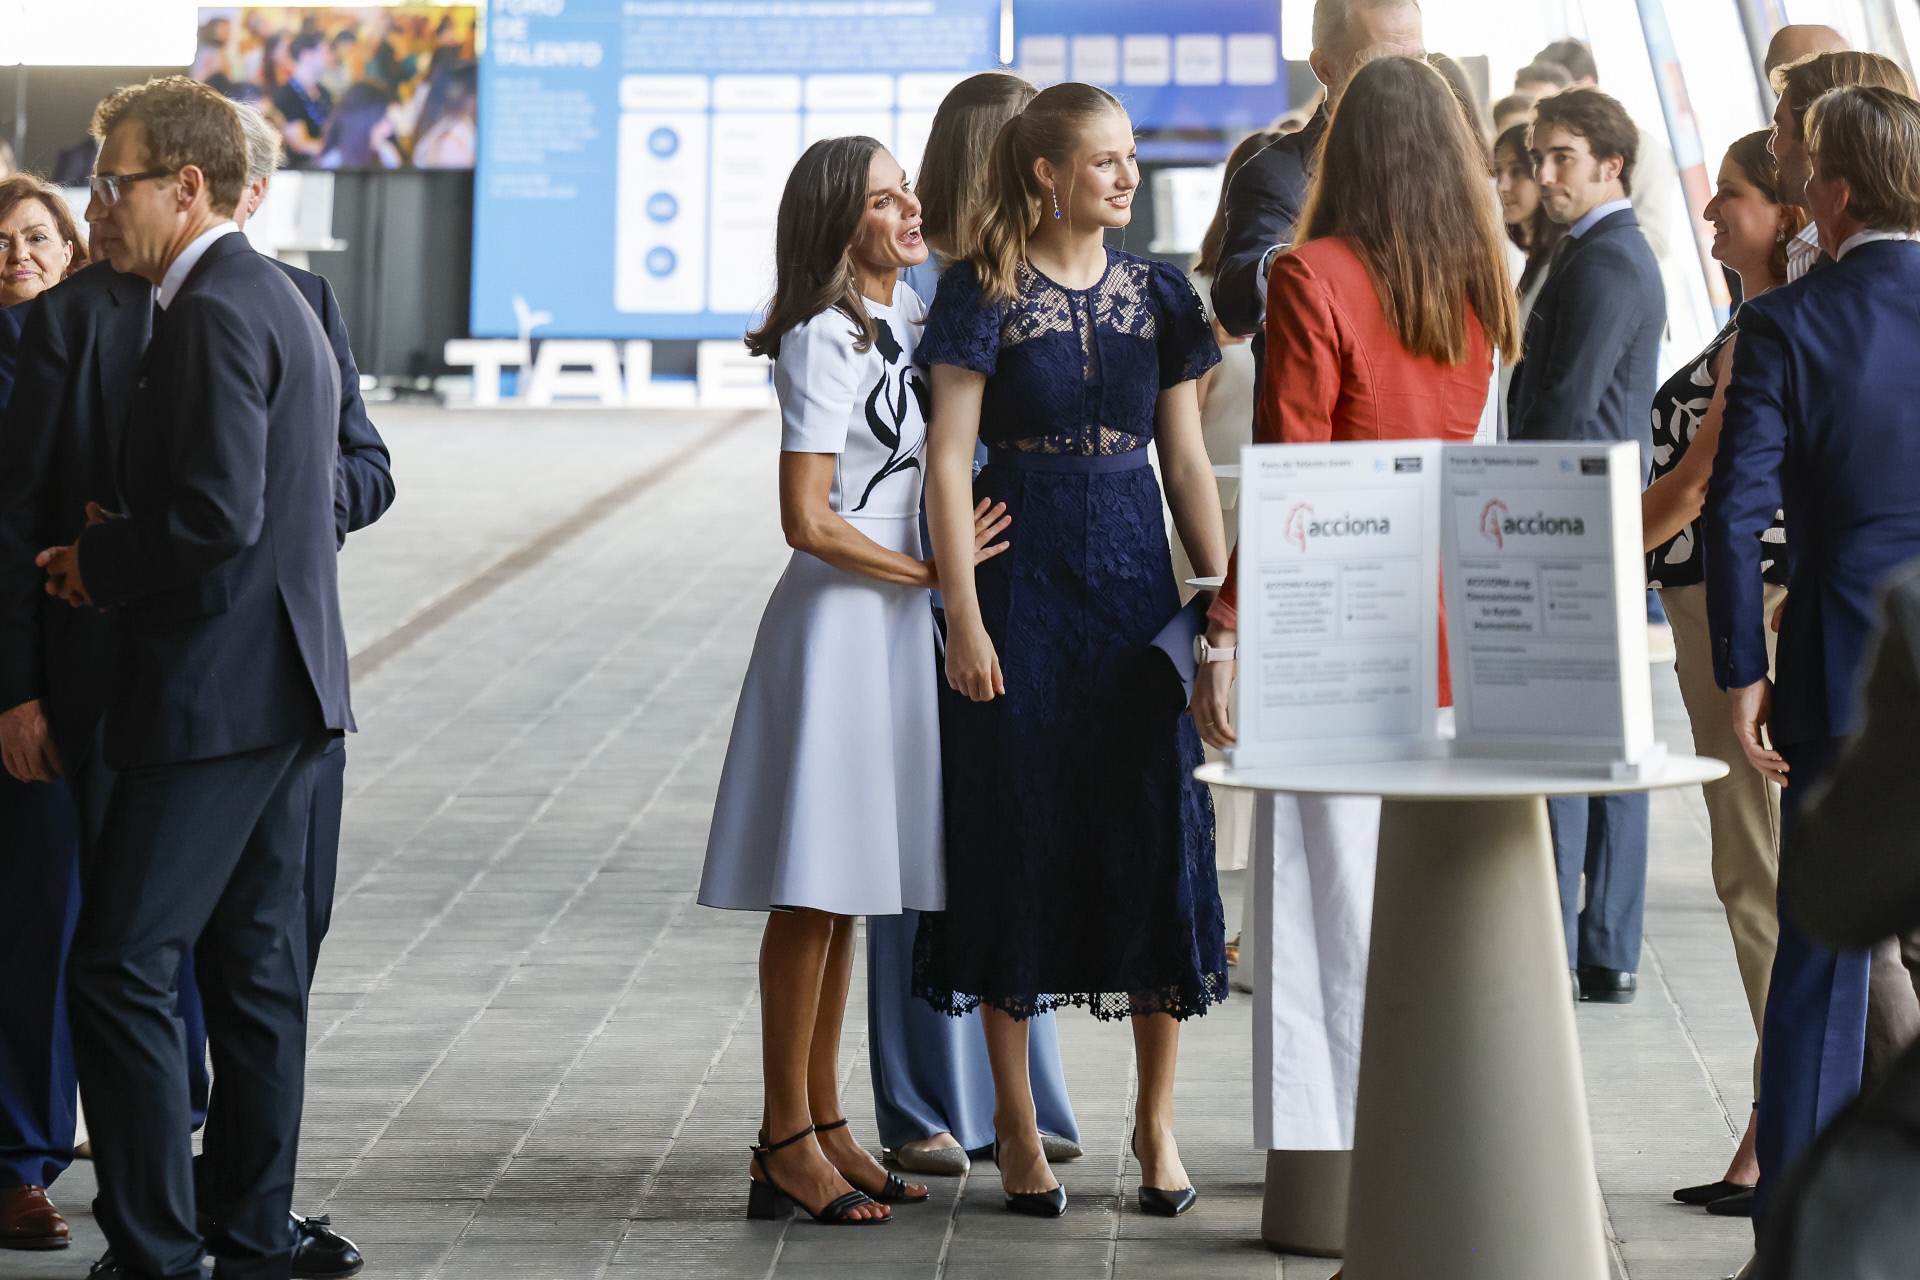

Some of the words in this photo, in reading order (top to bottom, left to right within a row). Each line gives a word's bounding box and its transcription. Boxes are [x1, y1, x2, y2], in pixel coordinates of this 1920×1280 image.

[494, 41, 603, 67] TALENTO
[1308, 513, 1391, 537] acciona
[1503, 511, 1585, 536] acciona
